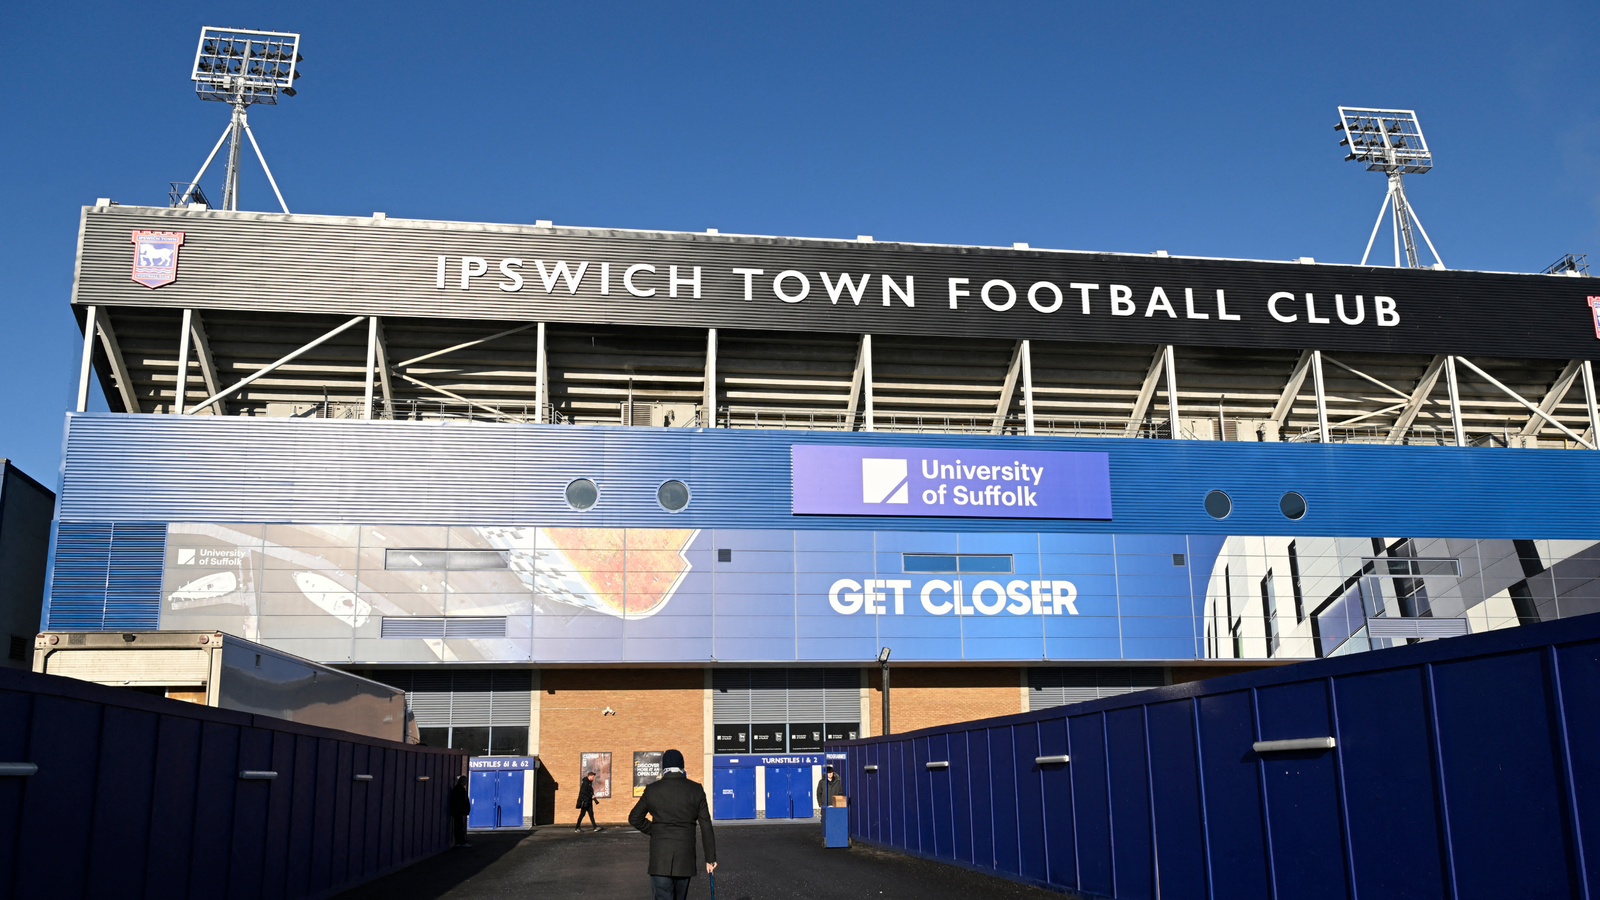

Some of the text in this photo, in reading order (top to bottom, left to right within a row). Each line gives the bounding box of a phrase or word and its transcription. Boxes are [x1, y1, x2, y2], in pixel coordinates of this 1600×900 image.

[436, 255, 1401, 327] IPSWICH TOWN FOOTBALL CLUB
[921, 459, 1044, 485] University
[922, 484, 1038, 506] of Suffolk
[199, 557, 242, 566] of Suffolk
[200, 549, 246, 558] University
[828, 578, 1080, 616] GET CLOSER
